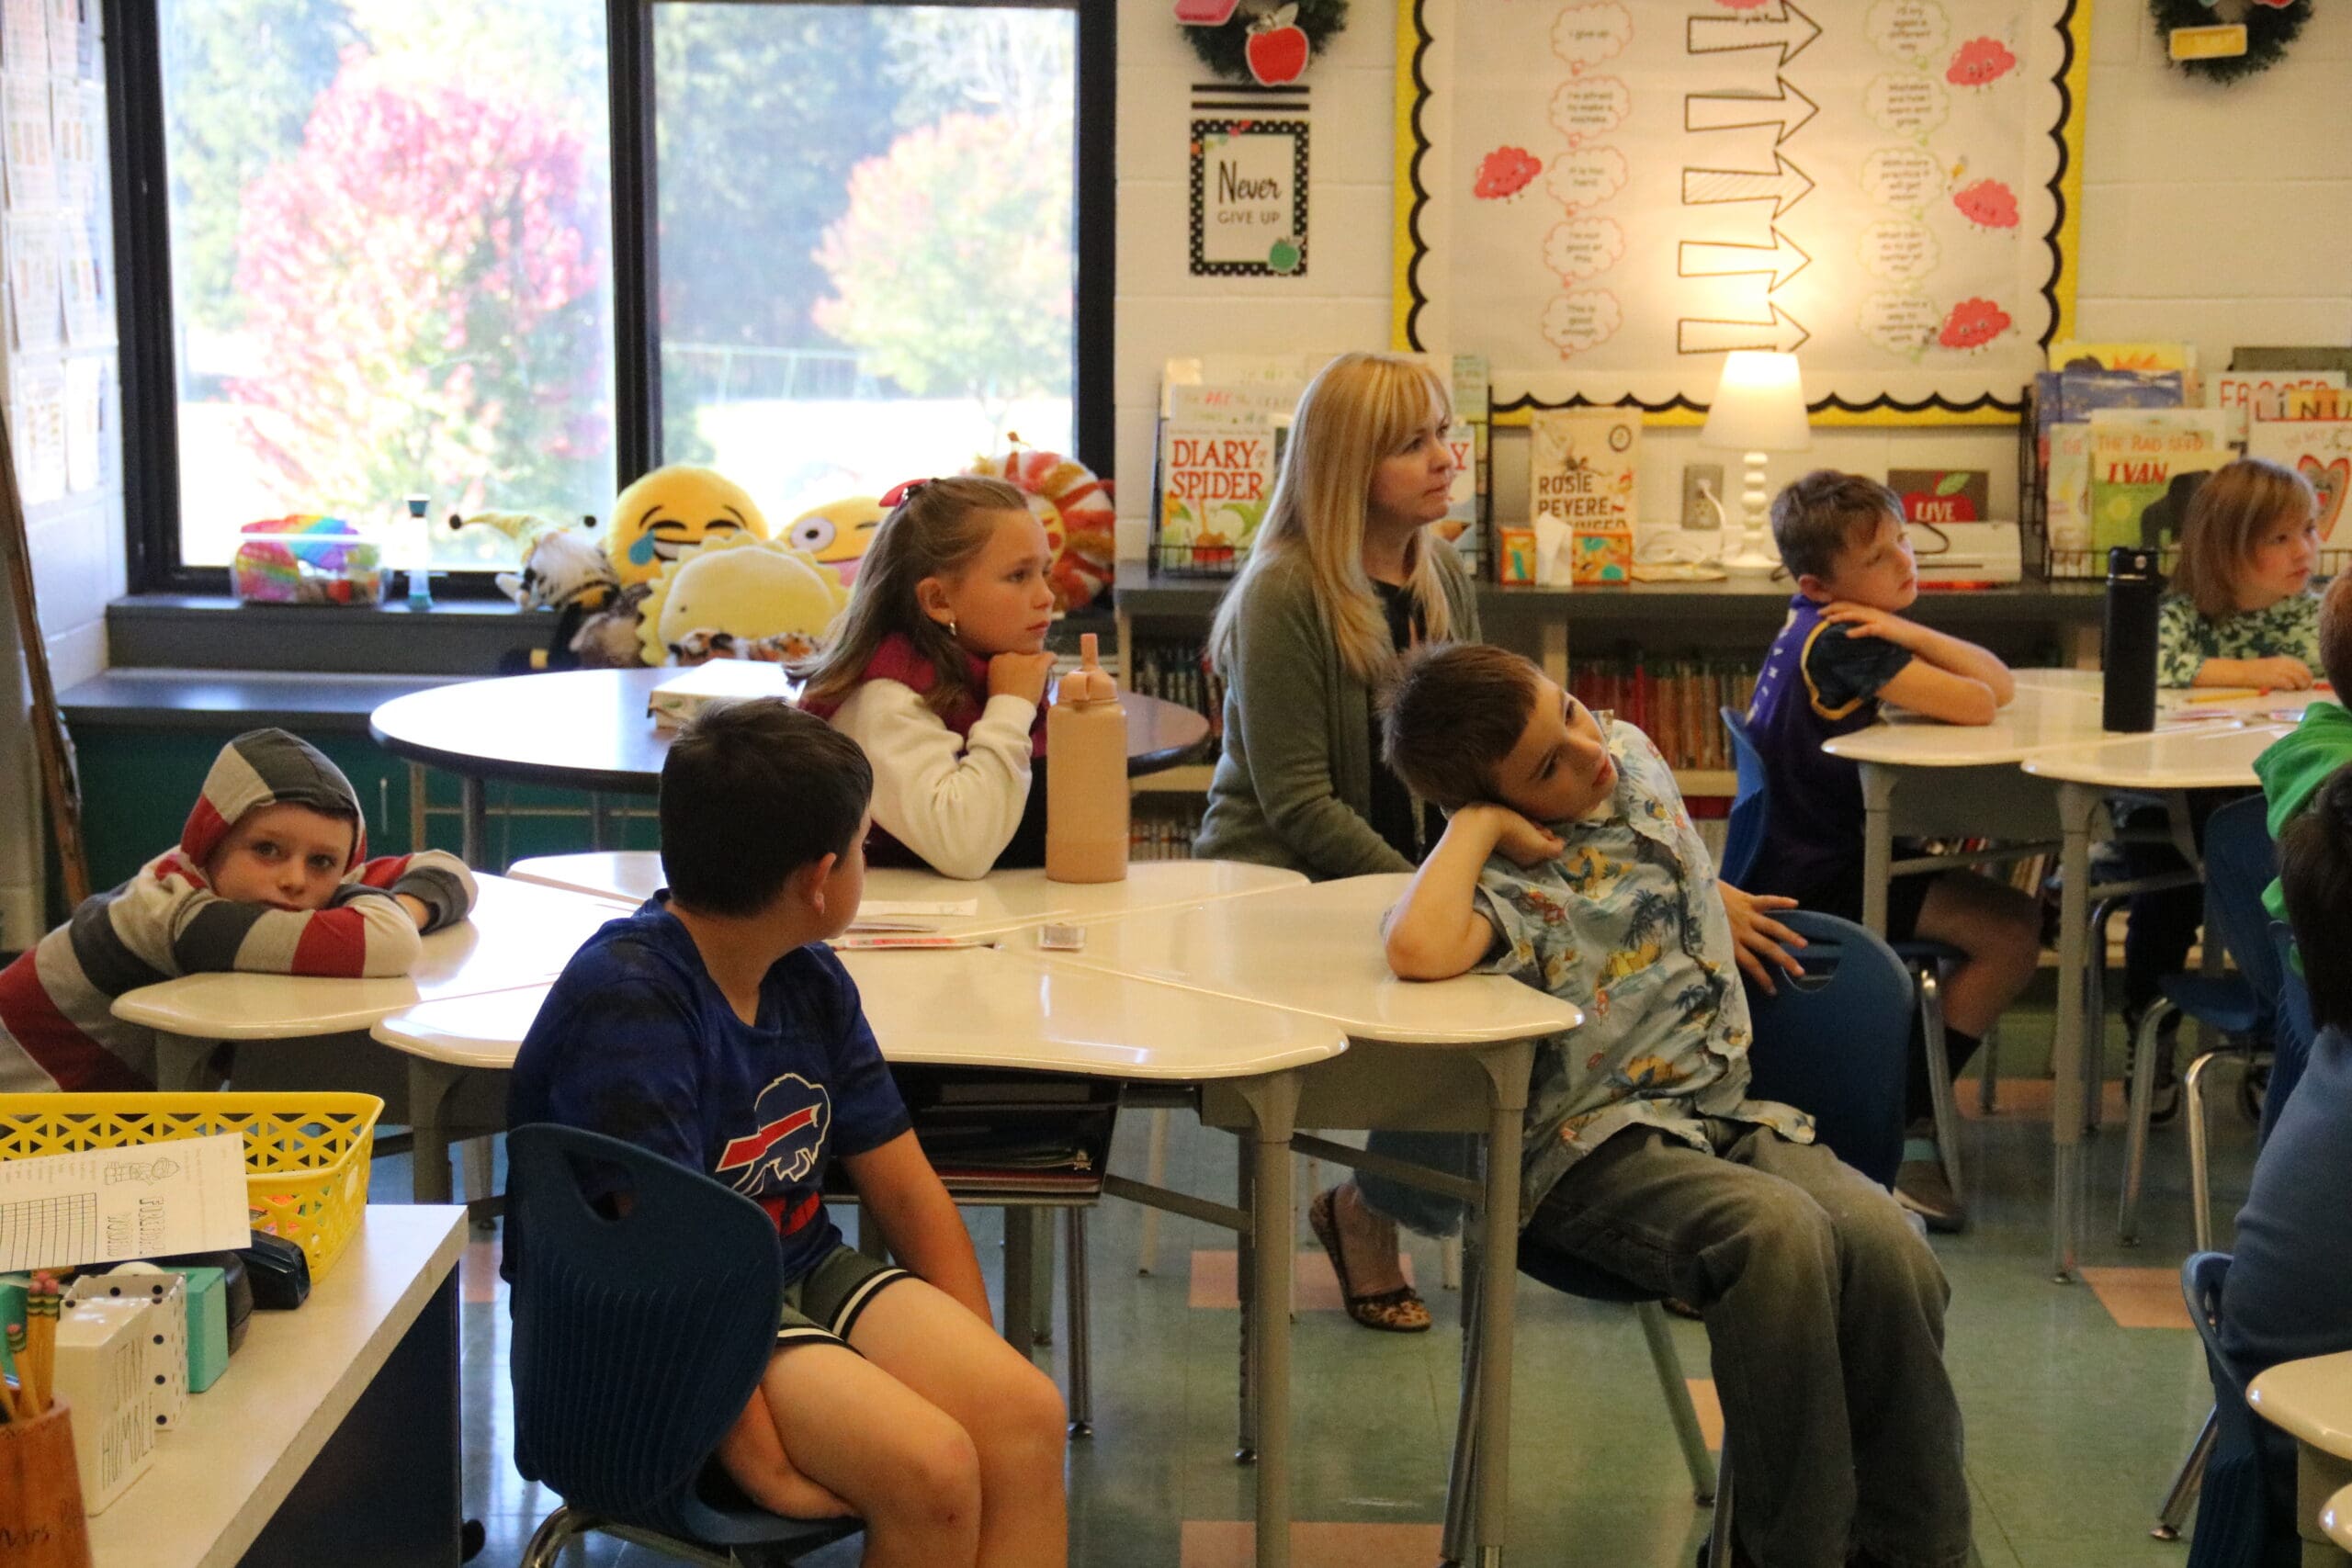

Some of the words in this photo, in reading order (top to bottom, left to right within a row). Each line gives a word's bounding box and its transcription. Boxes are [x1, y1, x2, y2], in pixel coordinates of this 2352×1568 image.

[1218, 160, 1283, 205] Never
[1217, 210, 1253, 225] GIVE
[1261, 210, 1282, 225] UP
[1170, 439, 1259, 469] DIARY
[1169, 471, 1265, 501] SPIDER
[1538, 474, 1594, 494] ROSIE
[2108, 461, 2168, 485] IVAN
[102, 1391, 155, 1492] HUMBLE
